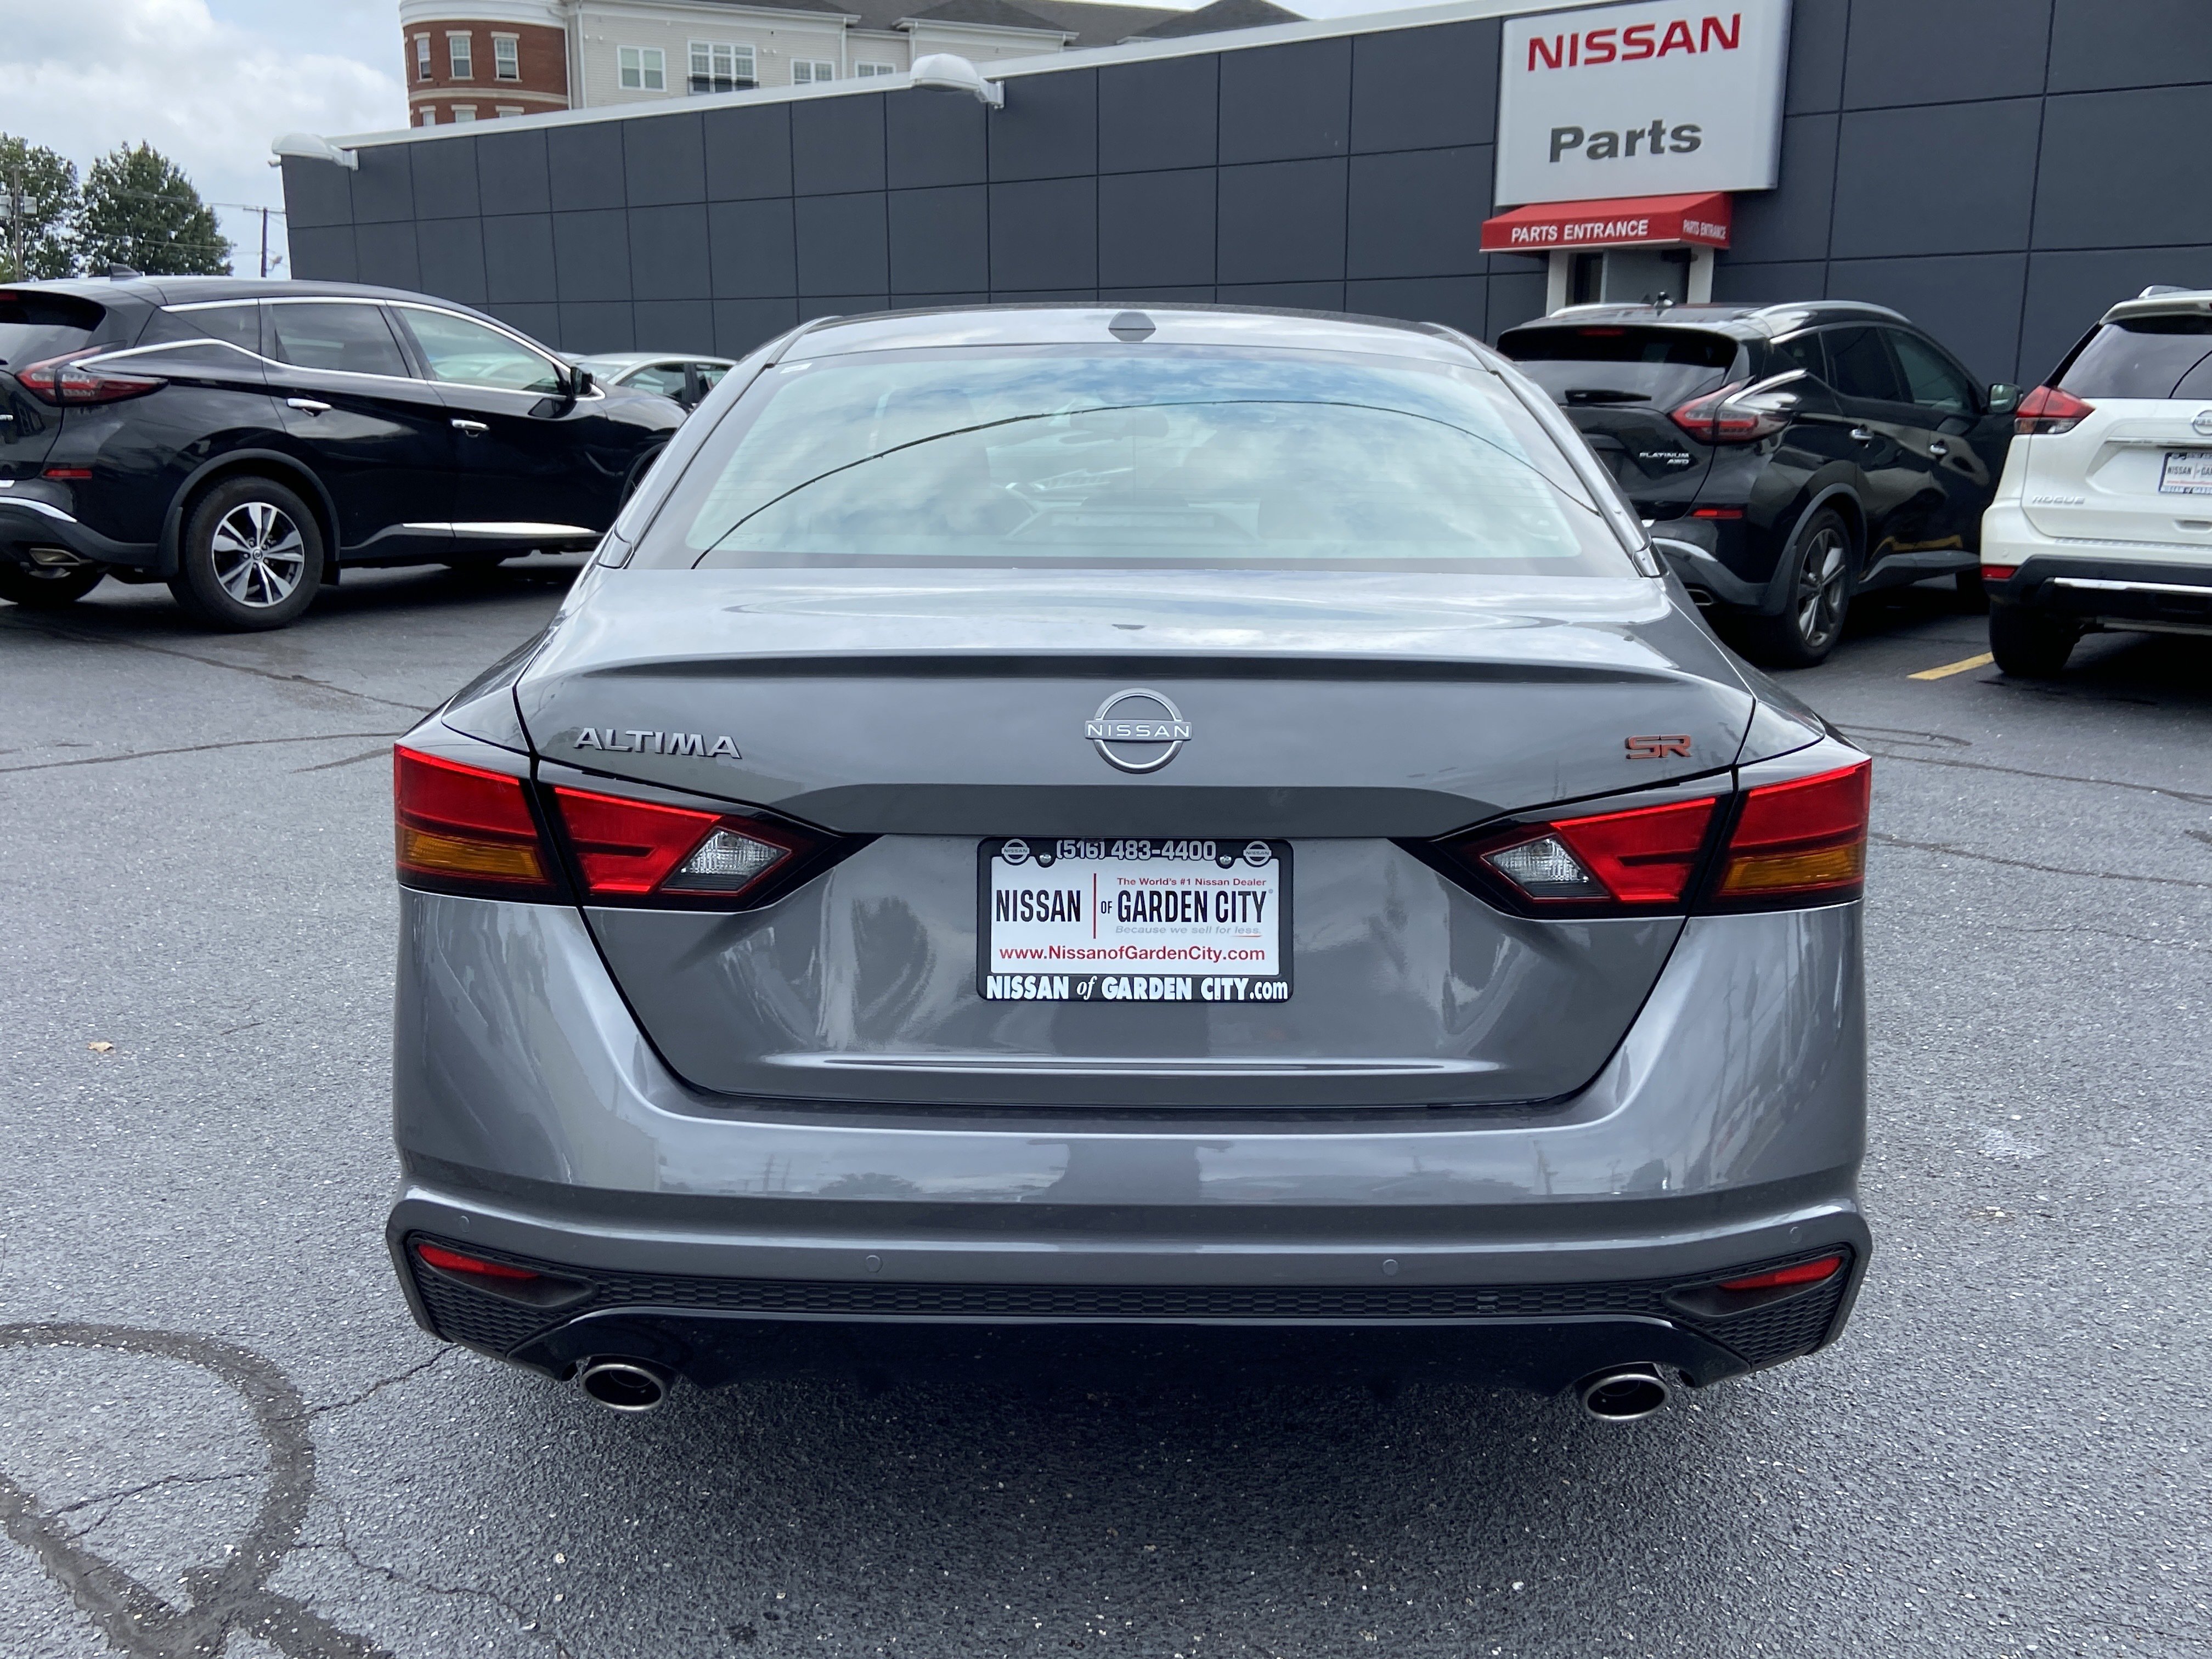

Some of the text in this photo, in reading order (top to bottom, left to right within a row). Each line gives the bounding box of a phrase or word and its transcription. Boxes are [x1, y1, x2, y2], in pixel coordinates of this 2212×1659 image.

[1528, 13, 1741, 72] NISSAN
[1549, 119, 1702, 163] Parts
[1511, 219, 1649, 243] PARTS ENTRANCE
[1683, 219, 1726, 240] PARTS ENTRANCE
[2032, 495, 2085, 505] ROGUE
[574, 727, 742, 759] ALTIMA
[1087, 724, 1190, 738] NISSAN
[1625, 733, 1692, 759] SR
[1056, 839, 1216, 861] (516) 483-4400
[1116, 877, 1267, 887] The World’s #1 Nissan Dealer
[996, 889, 1081, 923] NISSAN
[1101, 890, 1267, 923] OF GARDEN CITY
[1115, 925, 1166, 934] Because
[1191, 926, 1212, 934] sell
[1215, 926, 1232, 934] for
[1234, 926, 1262, 935] less.
[999, 945, 1266, 963] www.NissanofGardenCity.com
[986, 975, 1069, 1000] NISSAN
[1076, 975, 1098, 1001] of
[1101, 976, 1193, 1000] GARDEN
